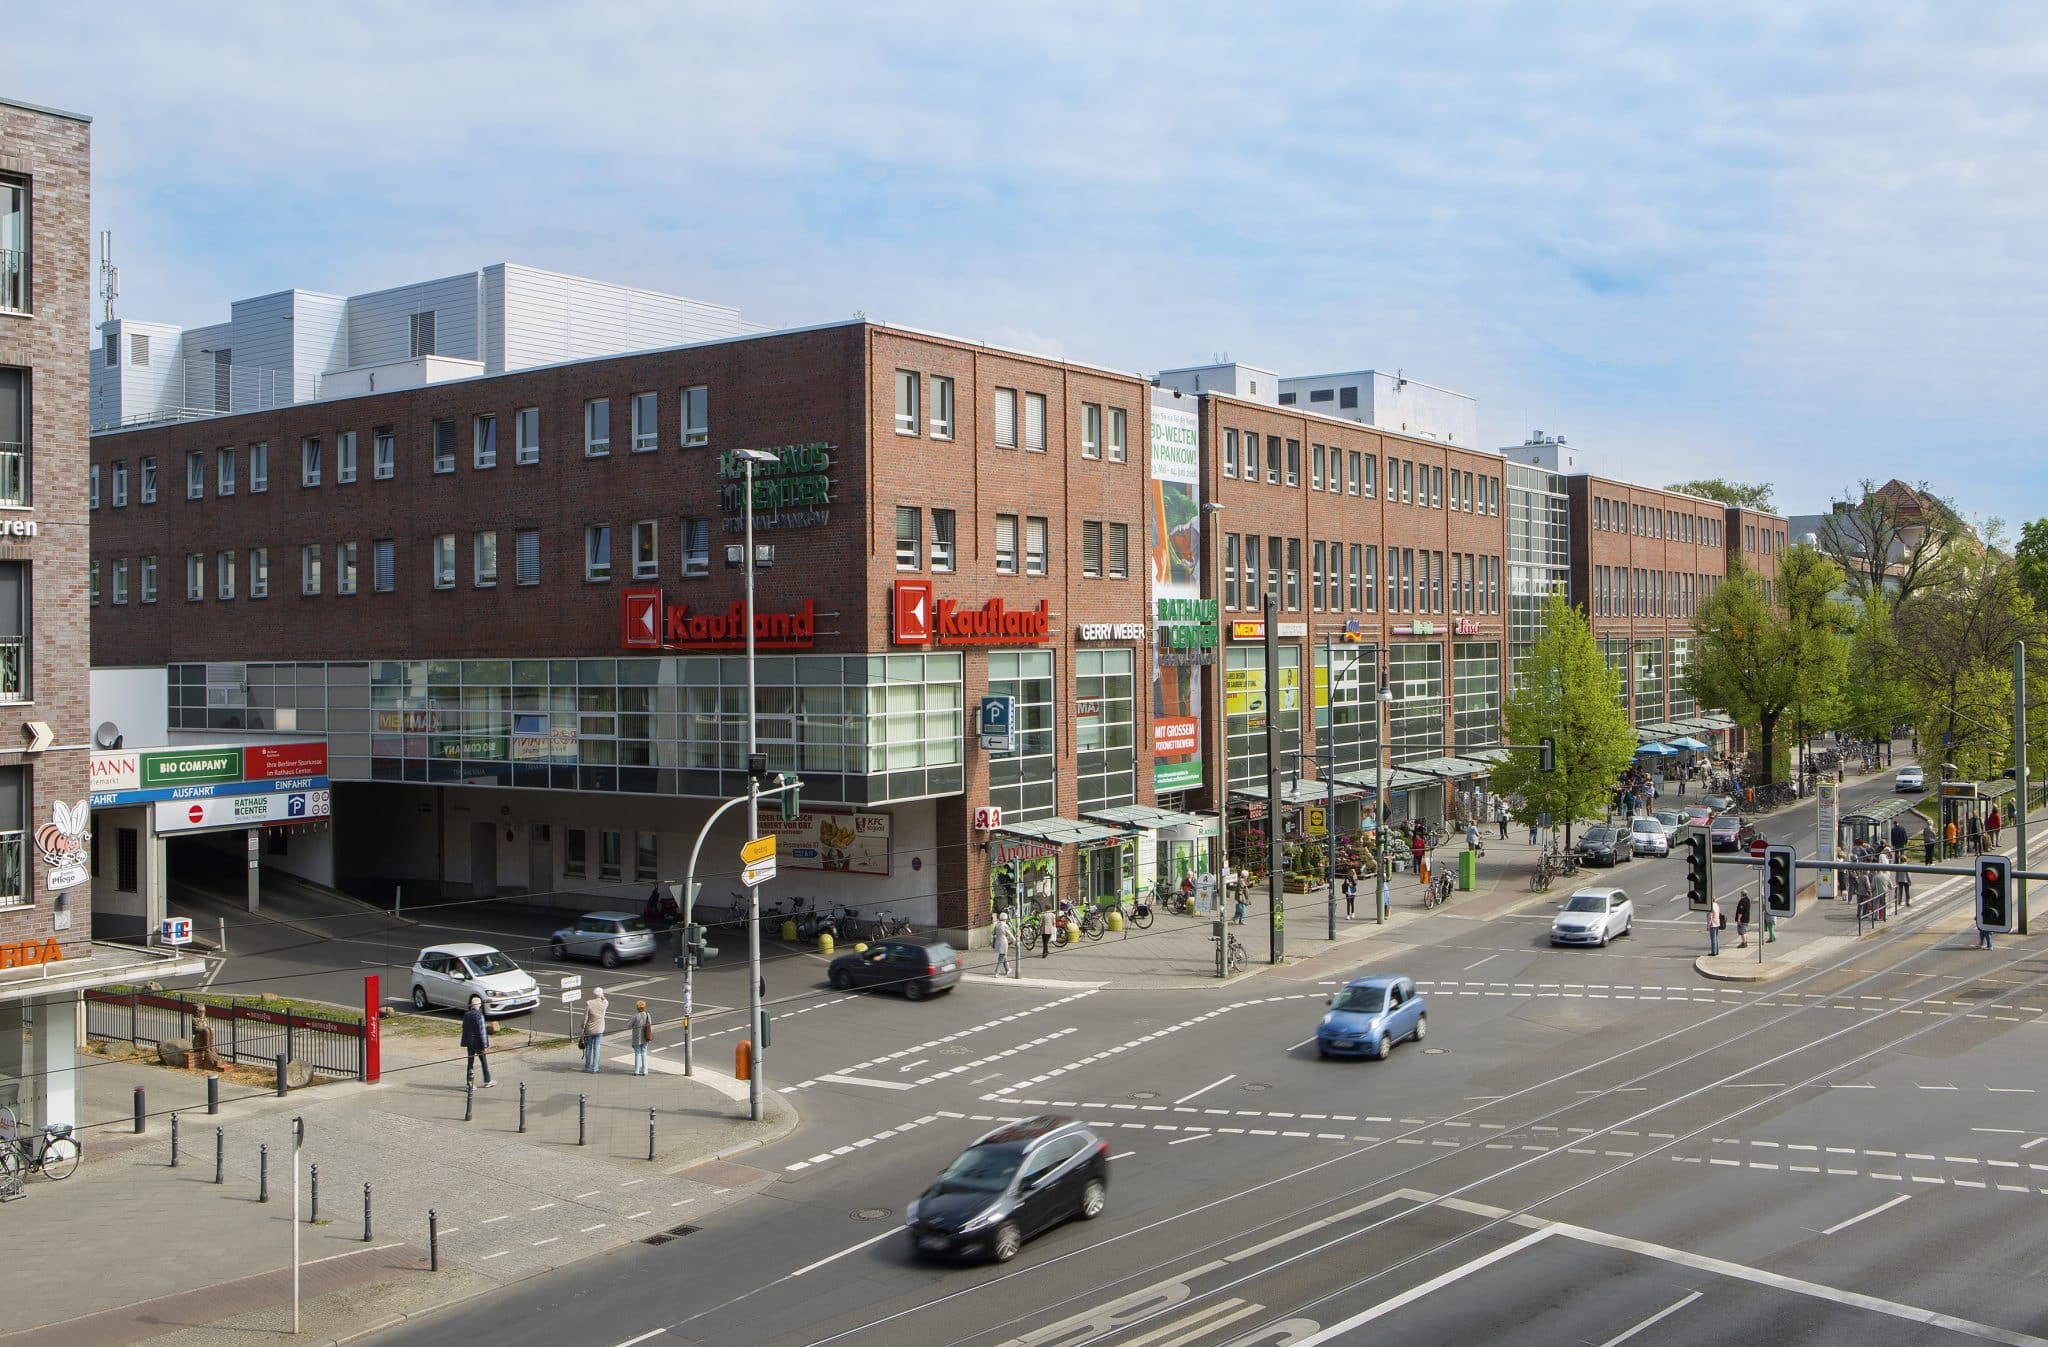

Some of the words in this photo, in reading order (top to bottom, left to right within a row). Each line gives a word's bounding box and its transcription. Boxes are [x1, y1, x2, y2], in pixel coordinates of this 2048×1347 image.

[937, 598, 1049, 636] Kaufland
[1158, 598, 1217, 621] RATHAUS
[667, 598, 815, 640] Kaufland
[1080, 623, 1112, 641] GERRY
[1113, 623, 1145, 640] WEBER
[1170, 625, 1217, 648] CENTER
[1235, 624, 1265, 636] MEDIM
[991, 707, 1000, 723] P
[1154, 726, 1166, 739] MIT
[1166, 723, 1195, 738] GROSSEM
[159, 762, 177, 774] BIO
[179, 759, 228, 773] COMPANY
[172, 786, 215, 798] AUSFAHRT
[275, 779, 312, 790] EINFAHRT
[235, 797, 267, 807] RATHAUS
[293, 801, 302, 815] P
[240, 806, 267, 815] CENTER
[867, 818, 884, 826] KFC
[52, 875, 76, 885] Pflege
[0, 936, 64, 970] RDA
